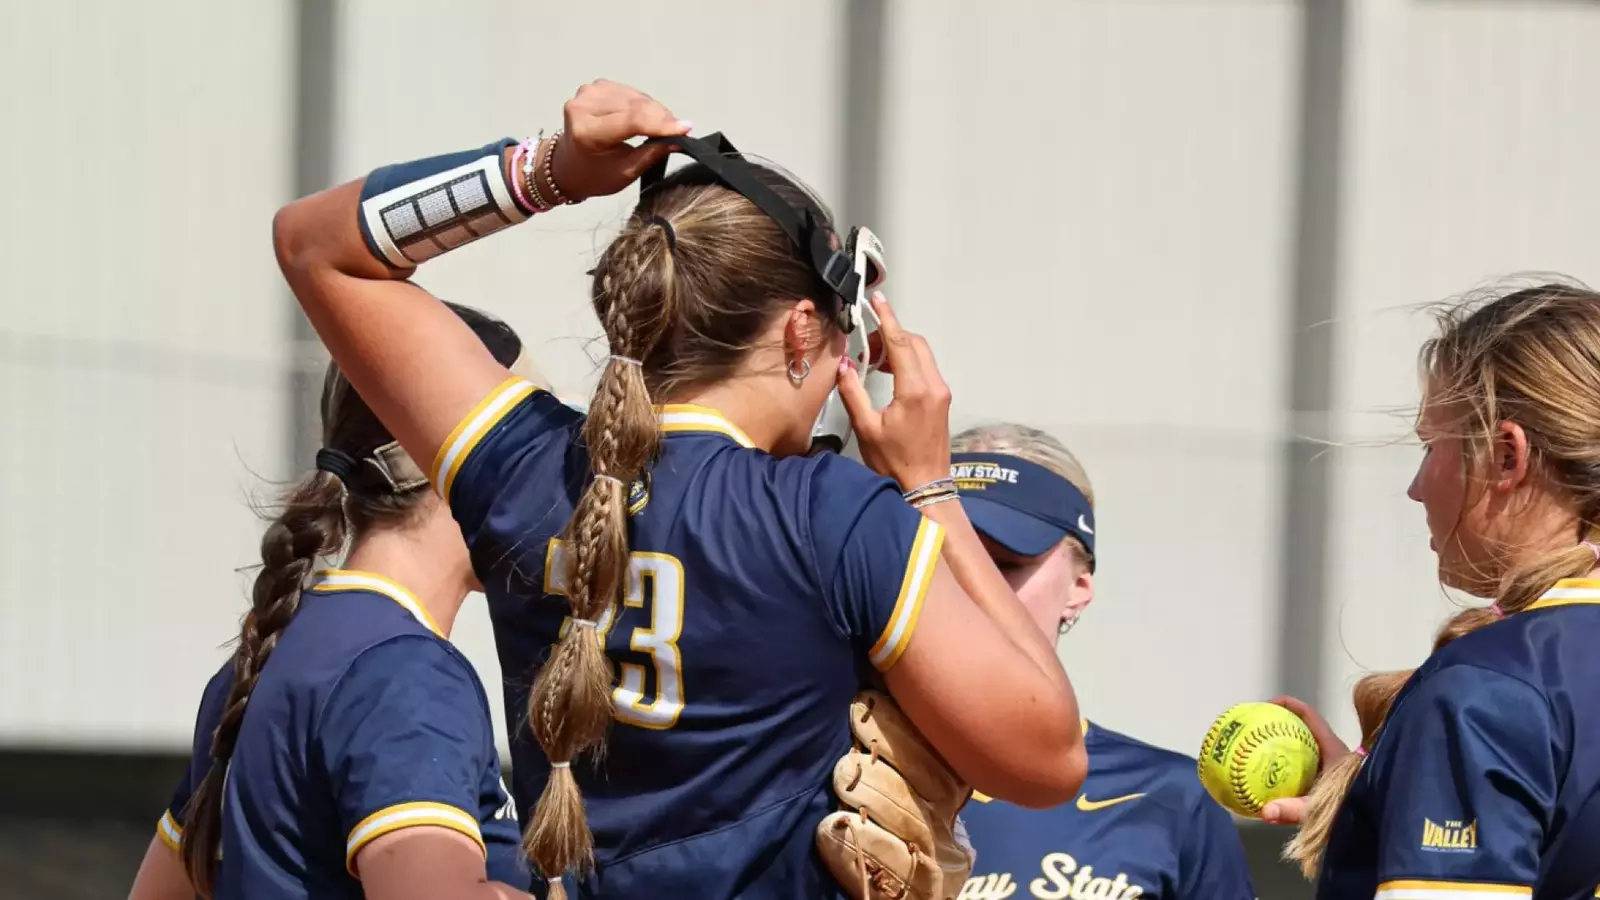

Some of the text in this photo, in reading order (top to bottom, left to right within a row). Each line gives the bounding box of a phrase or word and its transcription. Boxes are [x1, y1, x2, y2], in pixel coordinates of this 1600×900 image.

[974, 466, 1020, 484] STATE
[1212, 719, 1243, 764] NCAA
[1422, 816, 1479, 849] VALLEY
[1445, 819, 1463, 829] THE
